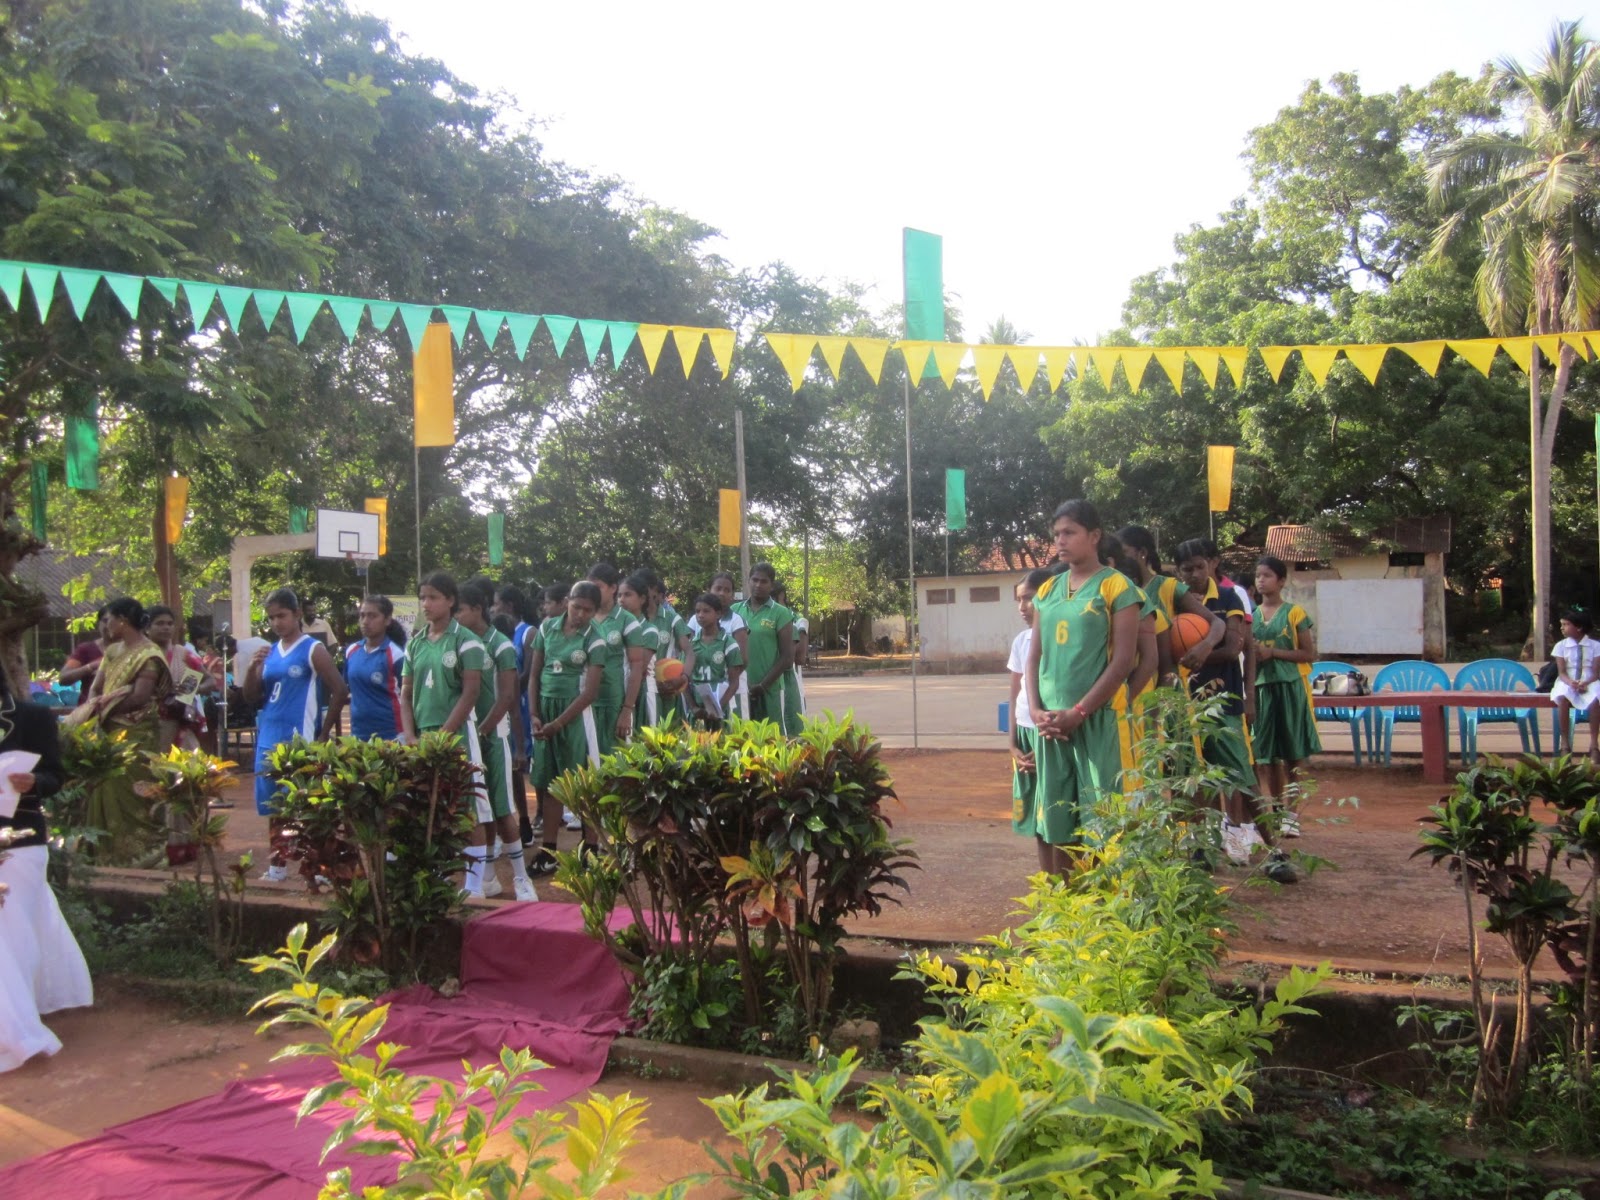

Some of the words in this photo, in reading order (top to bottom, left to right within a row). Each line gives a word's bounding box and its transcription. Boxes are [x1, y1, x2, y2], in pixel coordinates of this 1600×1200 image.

[1055, 620, 1069, 645] 6
[424, 668, 434, 689] 4
[269, 681, 281, 703] 9
